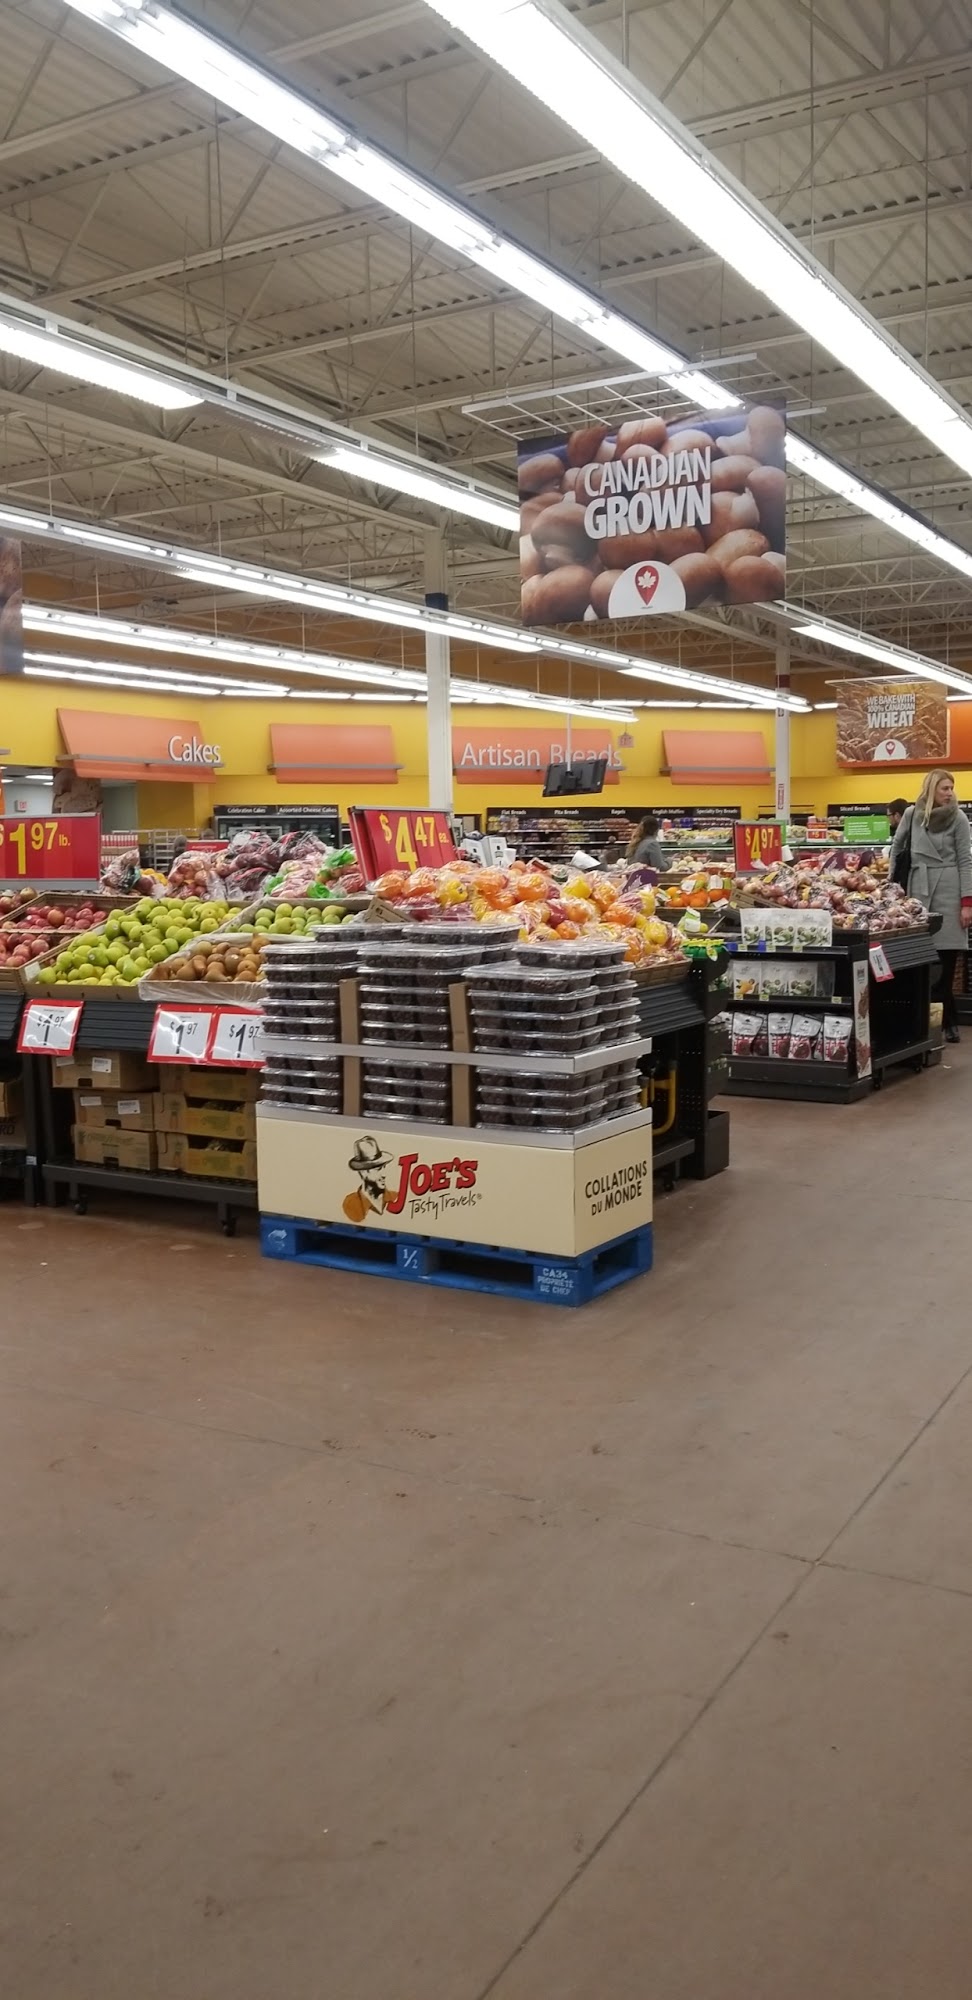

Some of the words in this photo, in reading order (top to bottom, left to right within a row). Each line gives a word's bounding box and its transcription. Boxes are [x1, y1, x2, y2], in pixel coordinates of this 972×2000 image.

[584, 446, 711, 497] CANADIAN
[584, 482, 712, 540] GROWN
[866, 696, 878, 705] WE
[879, 694, 898, 705] BAKE
[898, 693, 916, 703] WITH
[868, 705, 884, 713] 100%
[885, 703, 916, 712] CANADIAN
[867, 710, 916, 729] WHEAT
[168, 735, 221, 763] Cakes
[460, 742, 541, 766] Artisan
[550, 743, 623, 767] Beads
[253, 806, 266, 814] Cakes
[386, 1153, 478, 1215] JOE'S
[585, 1160, 648, 1199] COLLATIONS
[408, 1197, 438, 1220] Tasty
[592, 1200, 602, 1216] DU
[605, 1181, 642, 1211] MONDE
[543, 1267, 569, 1279] CA34
[540, 1284, 551, 1293] DE
